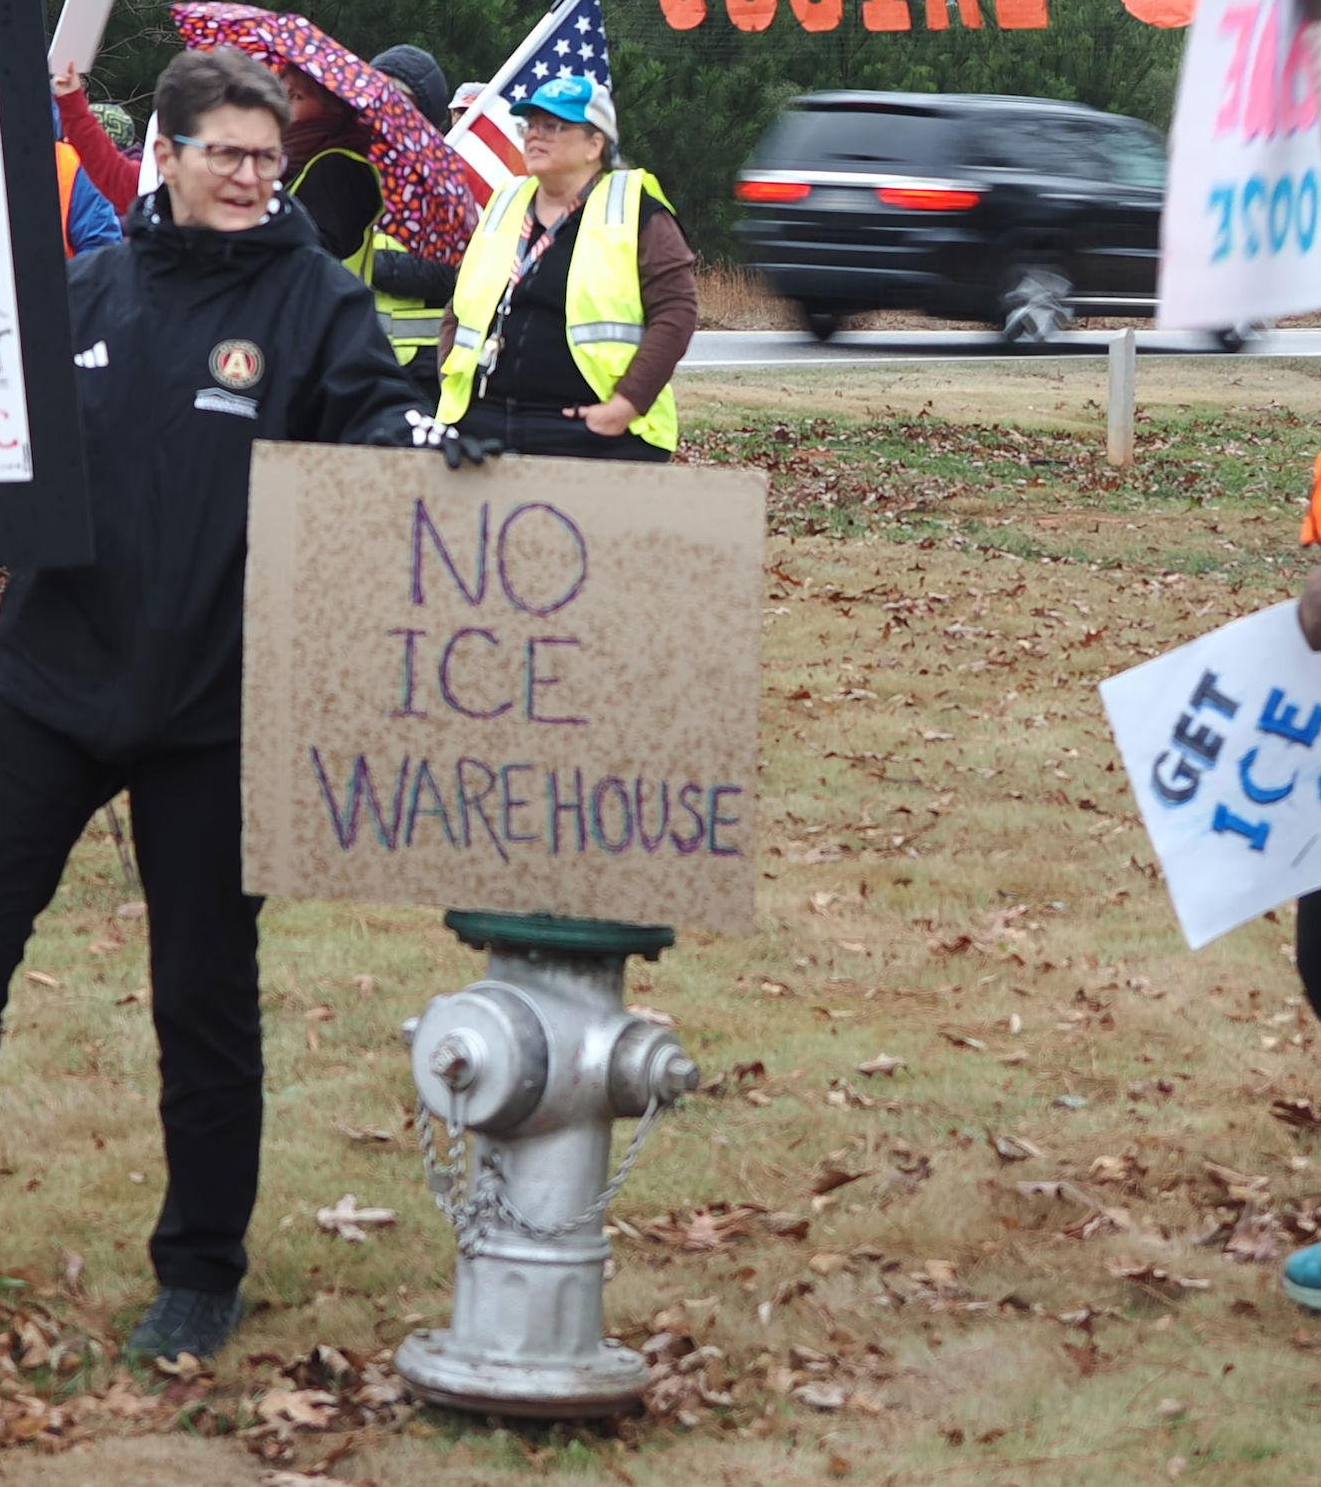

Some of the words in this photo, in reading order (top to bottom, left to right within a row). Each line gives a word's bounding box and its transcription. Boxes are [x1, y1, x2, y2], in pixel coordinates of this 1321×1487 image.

[410, 498, 588, 617] NO
[387, 627, 589, 726] ICE
[1151, 668, 1241, 809] GET
[309, 744, 744, 864] WAREHOUSE
